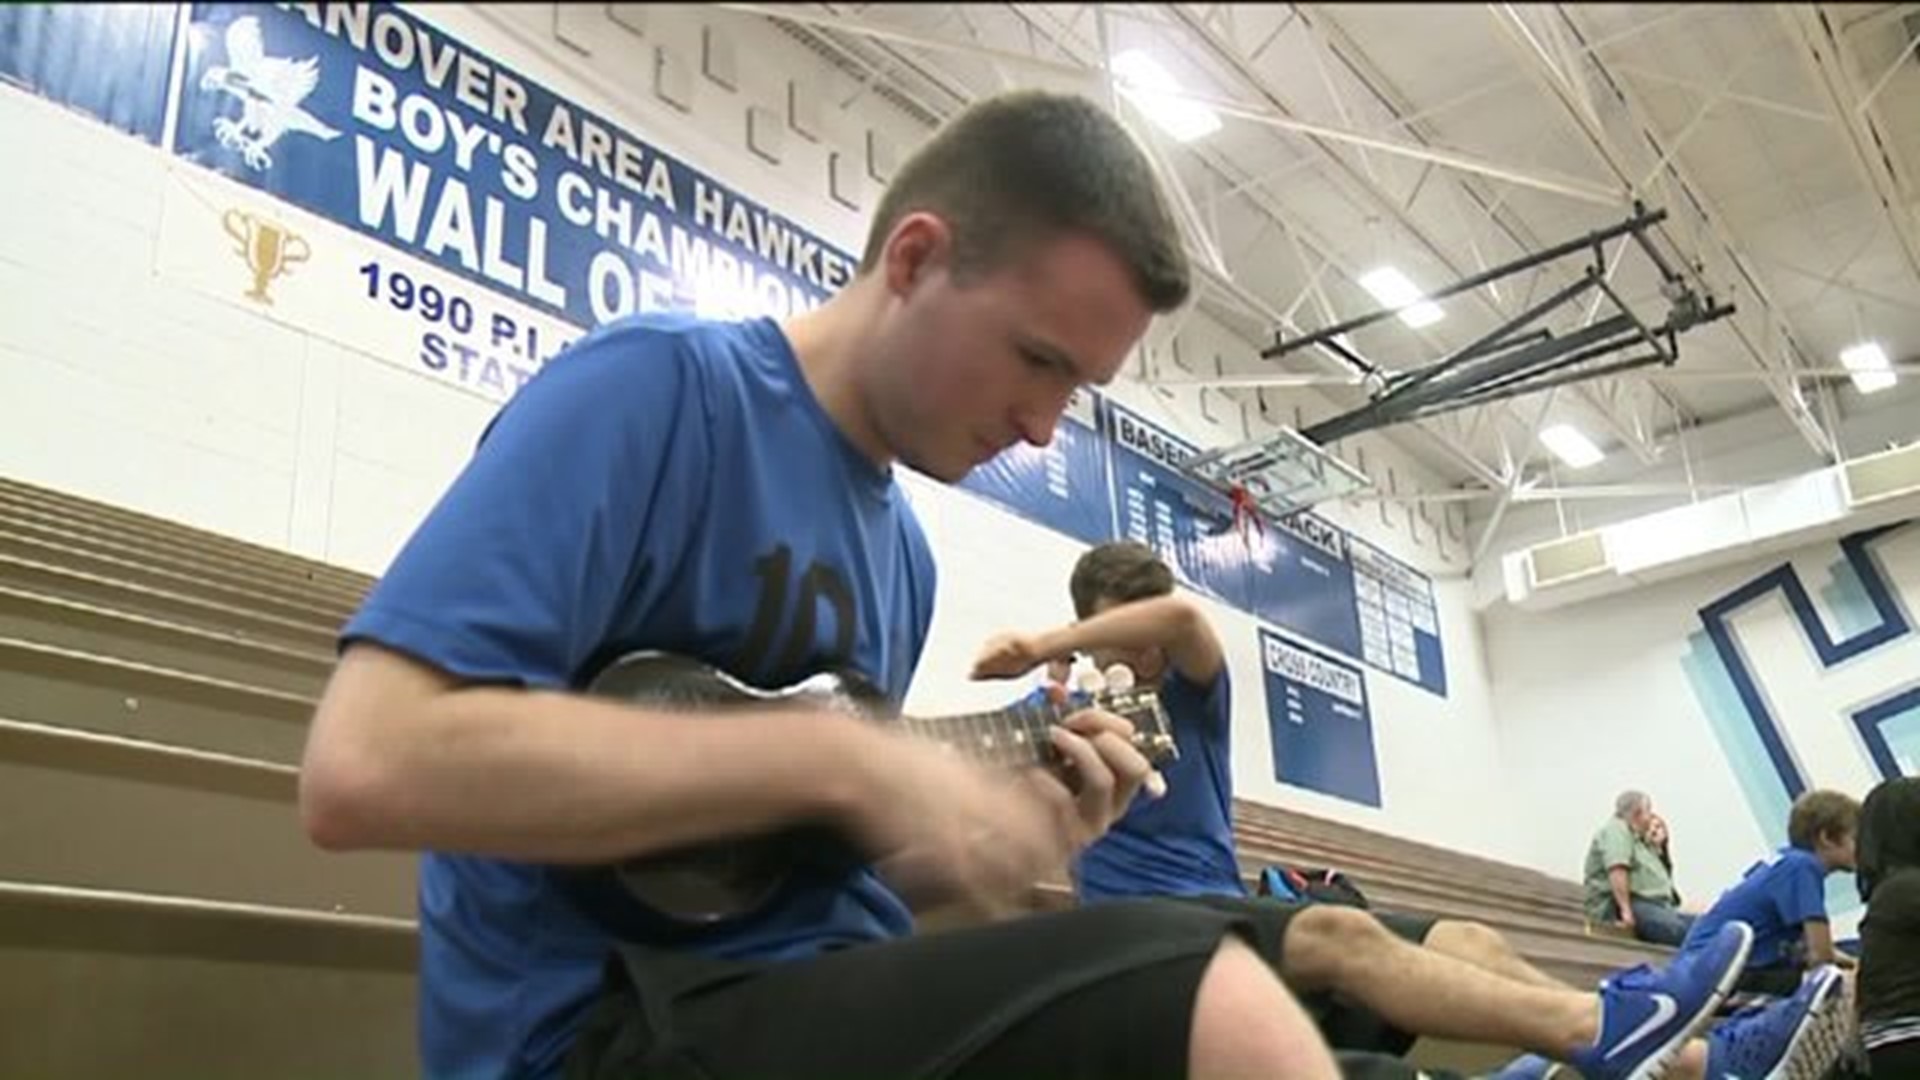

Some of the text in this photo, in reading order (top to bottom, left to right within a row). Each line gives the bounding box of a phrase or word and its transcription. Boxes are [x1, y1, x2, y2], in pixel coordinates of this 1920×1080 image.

[352, 65, 539, 200] BOY'S
[356, 134, 566, 310] WALL
[543, 104, 676, 211] AREA
[694, 181, 862, 299] HAWKE
[359, 262, 473, 334] 1990
[1120, 416, 1190, 466] BASE
[1281, 511, 1337, 553] ACK
[750, 542, 858, 664] 10
[1268, 642, 1358, 700] CROSS COUNTRY
